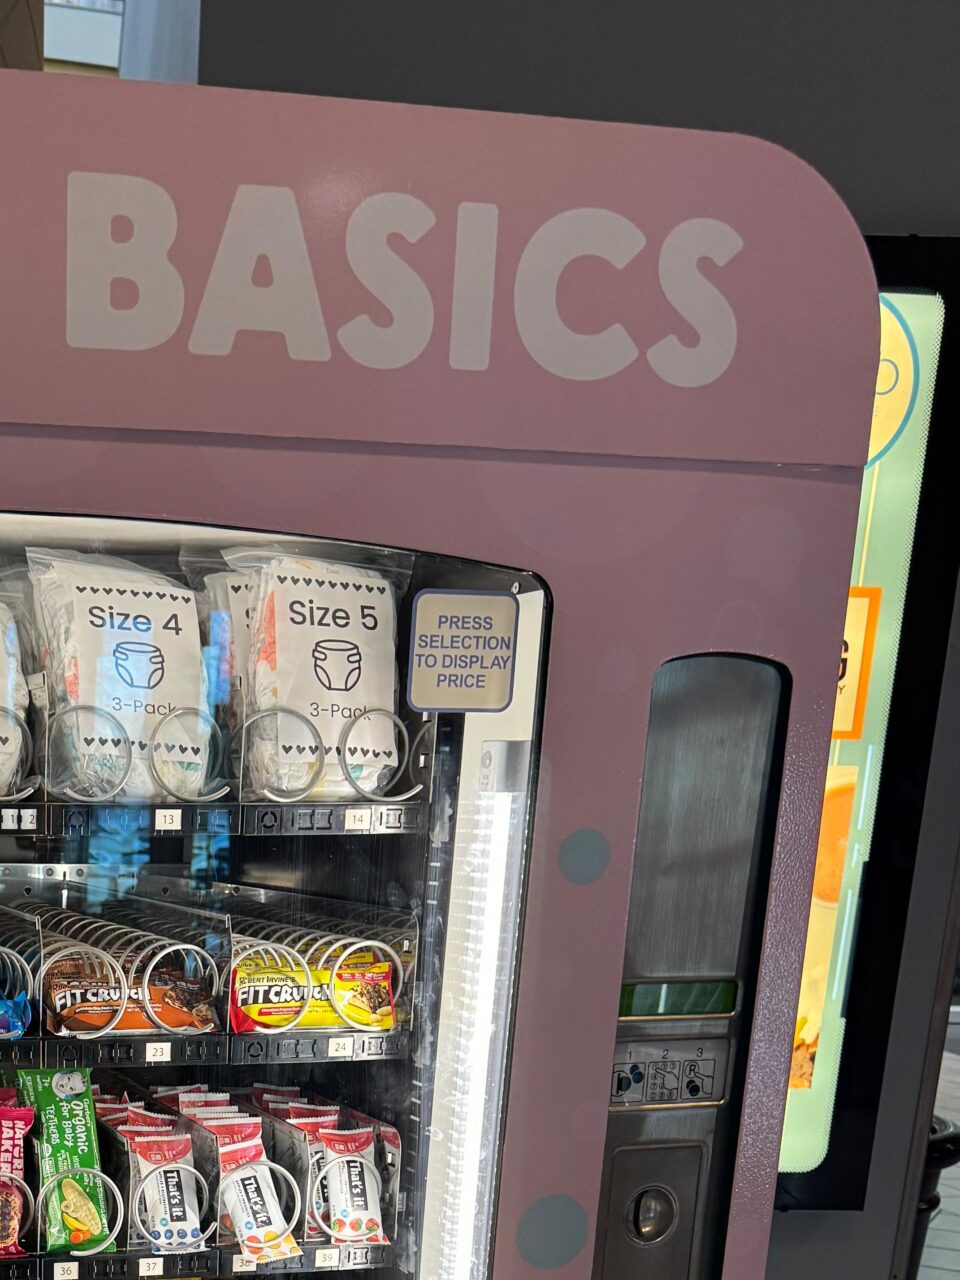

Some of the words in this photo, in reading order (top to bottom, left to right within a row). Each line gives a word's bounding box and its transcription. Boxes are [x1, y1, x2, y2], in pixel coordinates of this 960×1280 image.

[65, 170, 744, 388] BASICS
[87, 604, 152, 633] Size
[161, 612, 183, 636] 4
[288, 598, 351, 629] Size
[359, 604, 379, 631] 5
[437, 615, 493, 631] PRESS
[417, 634, 511, 651] SELECTION
[415, 653, 439, 669] TO
[441, 654, 512, 670] DISPLAY
[436, 674, 487, 689] PRICE
[111, 696, 177, 717] 3-Pack
[162, 814, 175, 826] 13
[351, 814, 364, 825] 14
[152, 1047, 164, 1057] 23
[334, 1042, 346, 1052] 24
[661, 1049, 669, 1059] 2
[696, 1047, 704, 1058] 3
[59, 1100, 71, 1119] for
[46, 1105, 61, 1146] TEETHERS
[70, 1099, 89, 1155] Organic
[61, 1120, 75, 1149] Baby
[348, 1161, 363, 1194] That's
[166, 1170, 182, 1205] That's
[244, 1177, 264, 1210] That's
[321, 1253, 333, 1263] 39
[60, 1267, 72, 1276] 36
[145, 1262, 157, 1272] 37
